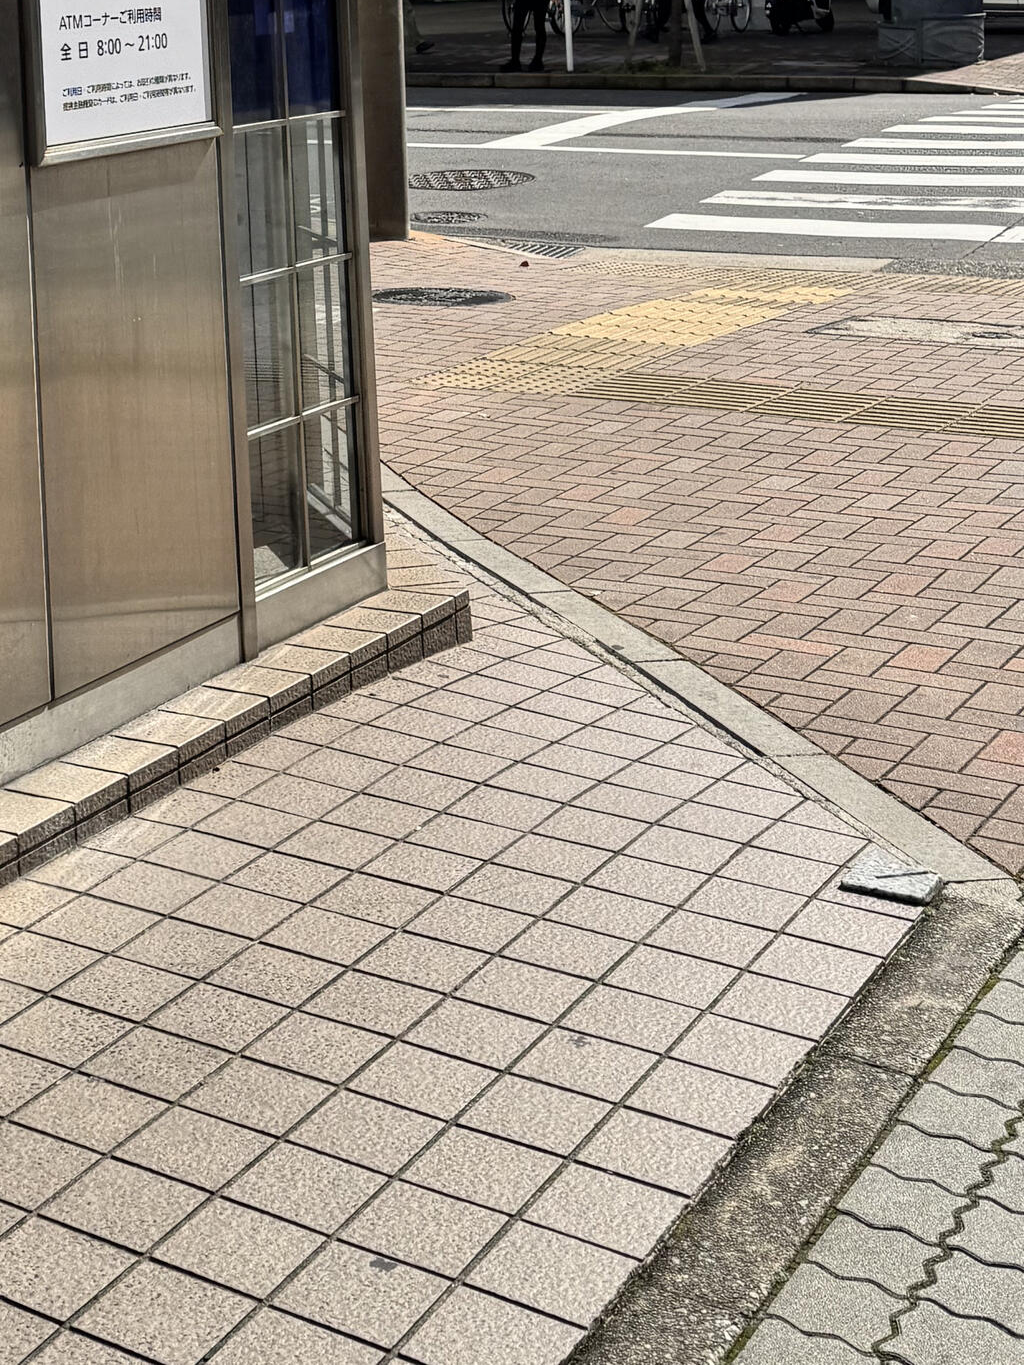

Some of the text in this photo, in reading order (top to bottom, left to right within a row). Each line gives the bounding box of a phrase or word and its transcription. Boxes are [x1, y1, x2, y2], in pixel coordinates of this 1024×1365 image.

[59, 6, 162, 30] ATMコーナーご利用時間
